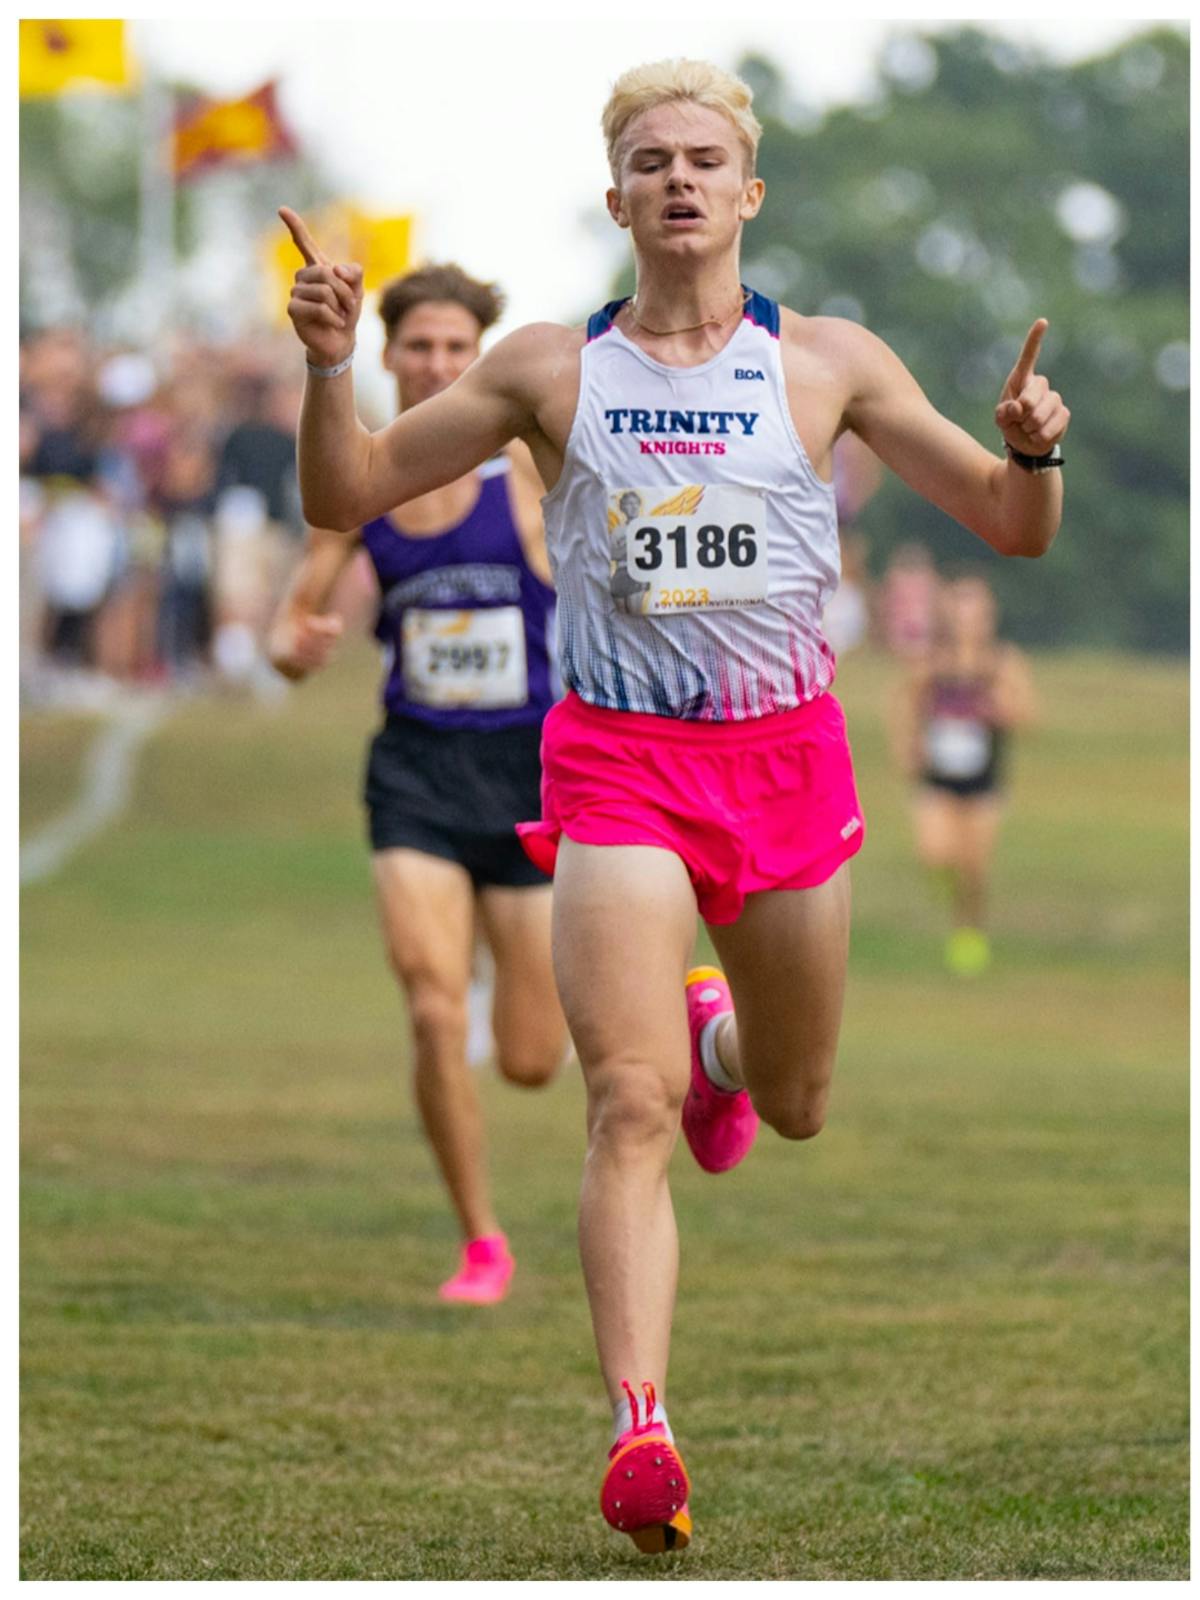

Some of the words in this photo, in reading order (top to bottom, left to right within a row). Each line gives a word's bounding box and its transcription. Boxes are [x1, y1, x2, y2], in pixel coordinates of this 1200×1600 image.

[734, 368, 765, 381] BOA
[605, 408, 759, 435] TRINITY
[639, 440, 727, 456] KNIGHTS
[634, 523, 758, 571] 3186
[659, 587, 710, 606] 2023
